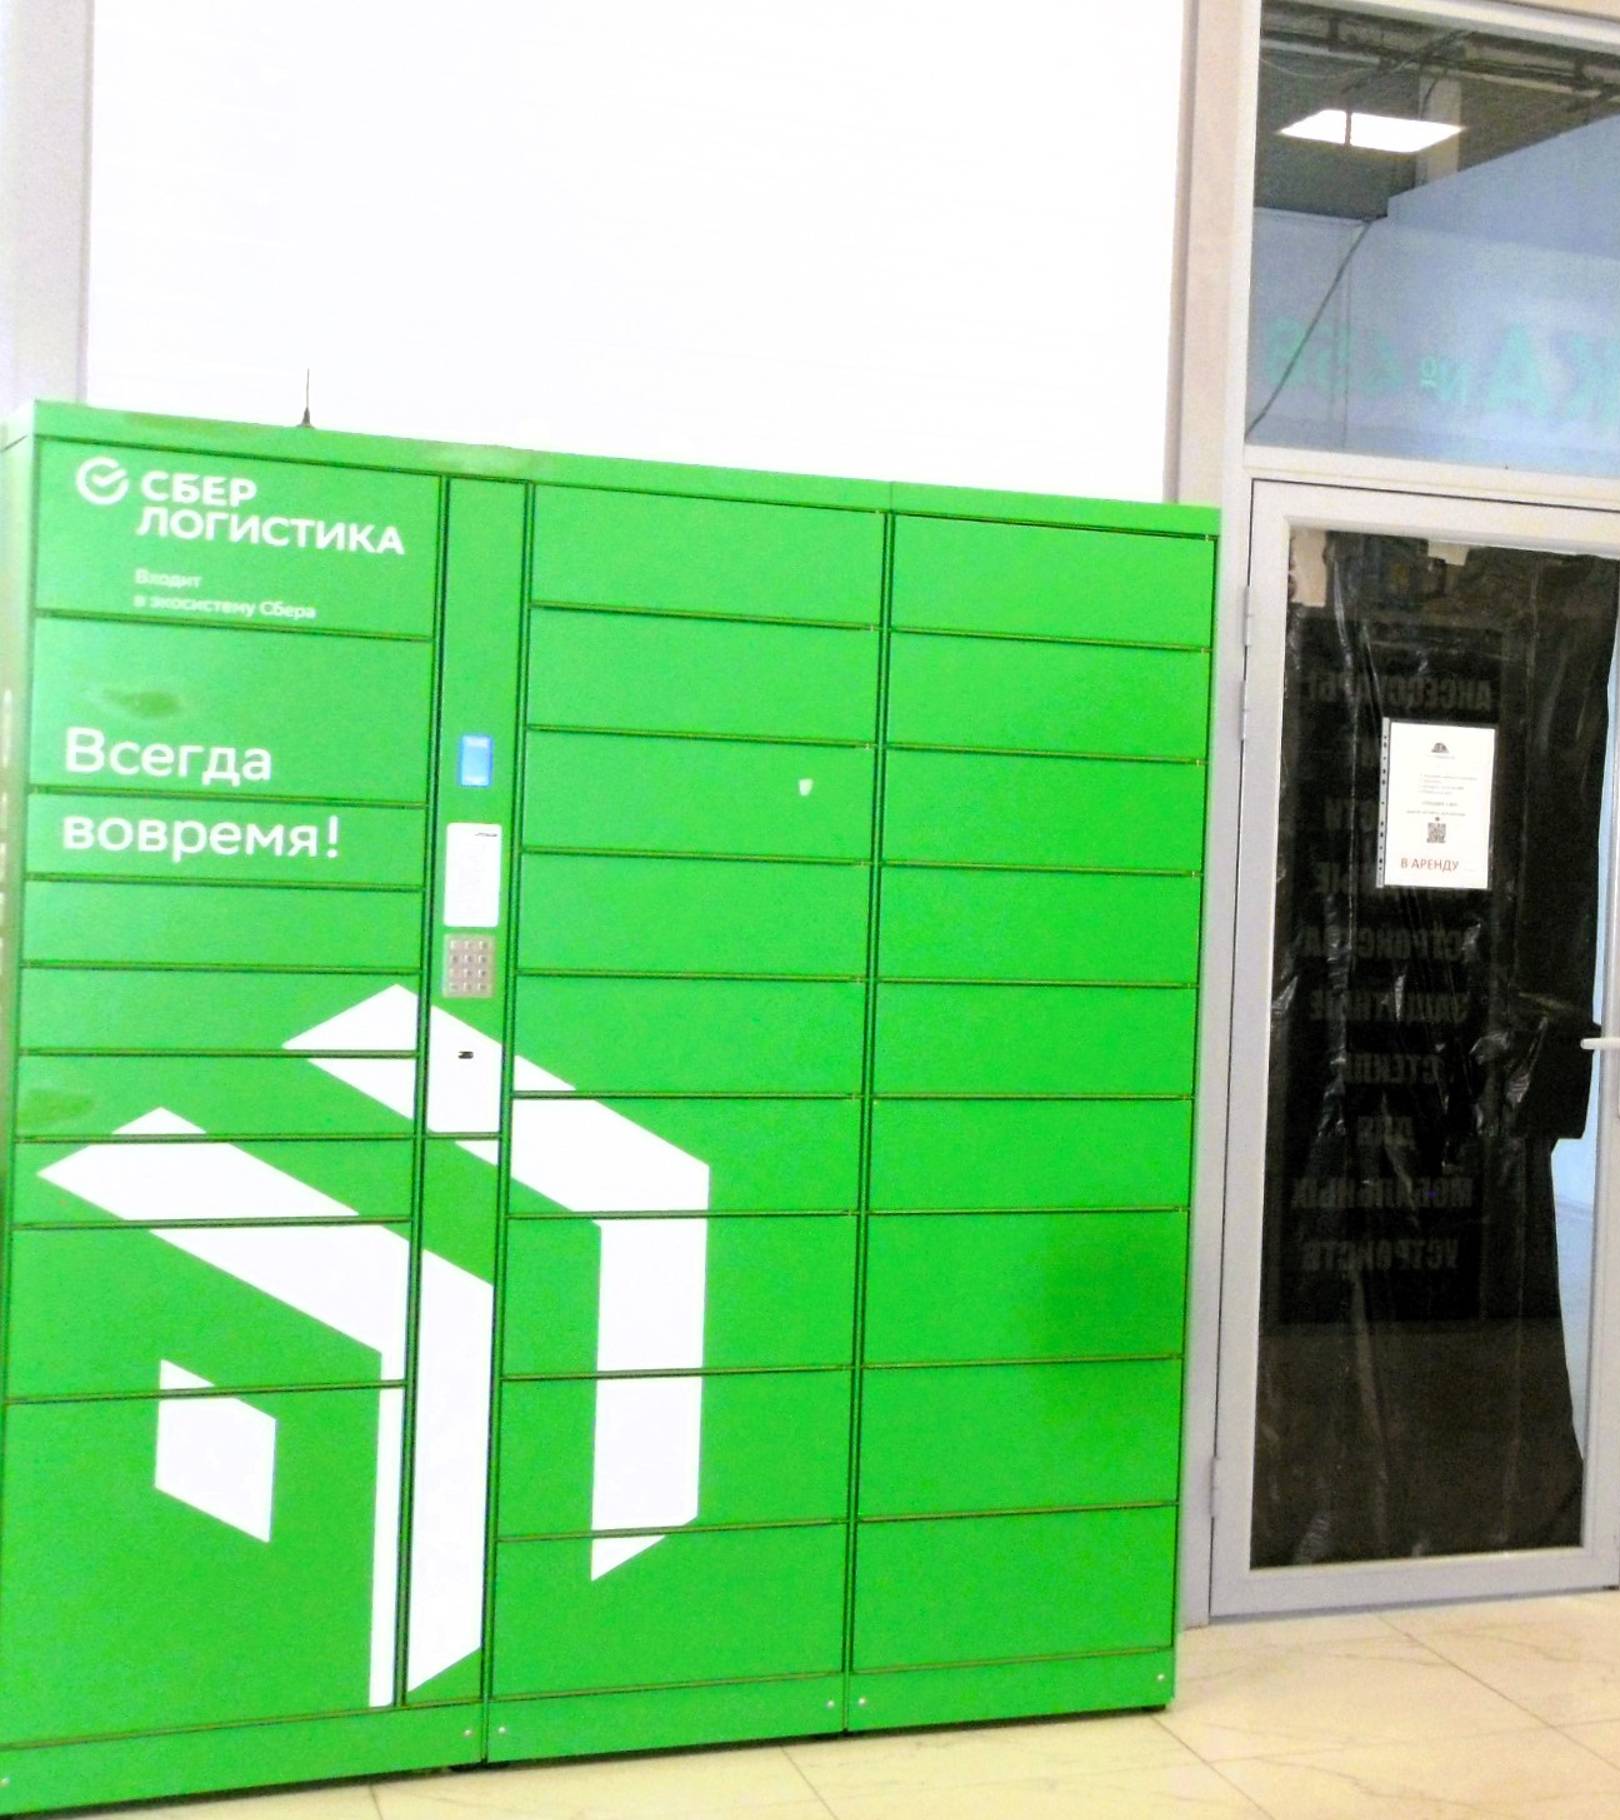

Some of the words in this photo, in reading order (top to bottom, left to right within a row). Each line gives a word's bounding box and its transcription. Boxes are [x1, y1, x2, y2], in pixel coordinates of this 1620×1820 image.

[141, 470, 258, 508] СБЕР
[136, 508, 405, 556] ЛОГИСТИКА
[135, 568, 202, 591] Входит
[133, 596, 146, 609] в
[150, 596, 257, 619] экосистему
[260, 600, 317, 622] Сбера
[66, 727, 273, 786] Всегда
[63, 814, 341, 863] вовремя!
[1400, 857, 1408, 869] В
[1411, 858, 1459, 872] АРЕНДУ
